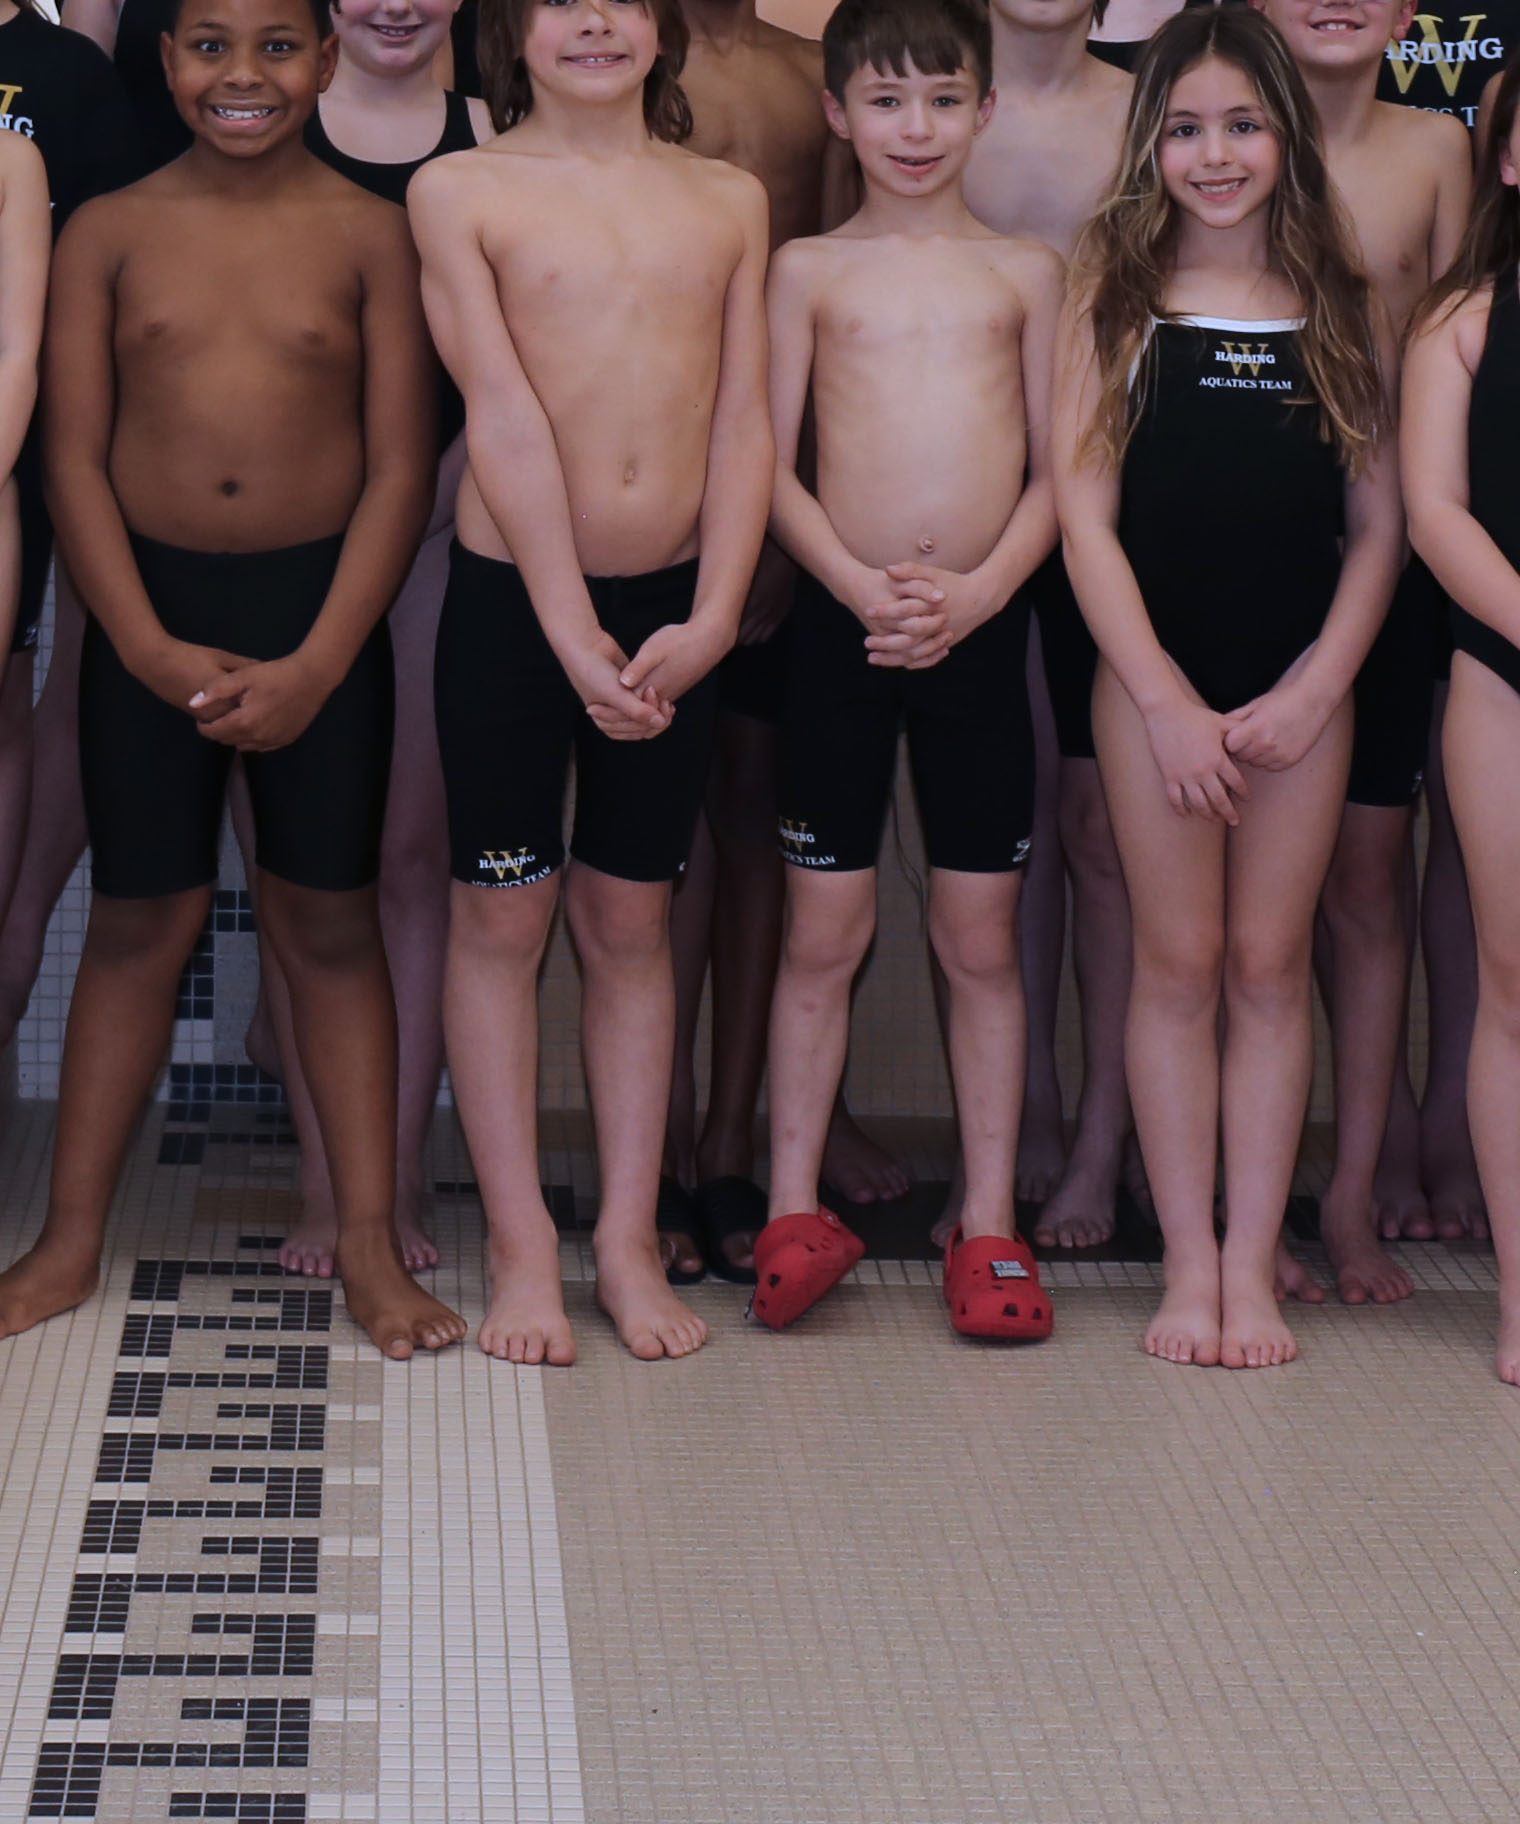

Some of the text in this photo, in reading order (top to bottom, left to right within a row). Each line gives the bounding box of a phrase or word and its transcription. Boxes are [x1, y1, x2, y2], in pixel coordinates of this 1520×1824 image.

[1384, 37, 1504, 65] ARDING
[1214, 350, 1276, 365] HARDING
[1198, 376, 1293, 391] AQUATICS TEAM
[478, 854, 536, 869] HARDING
